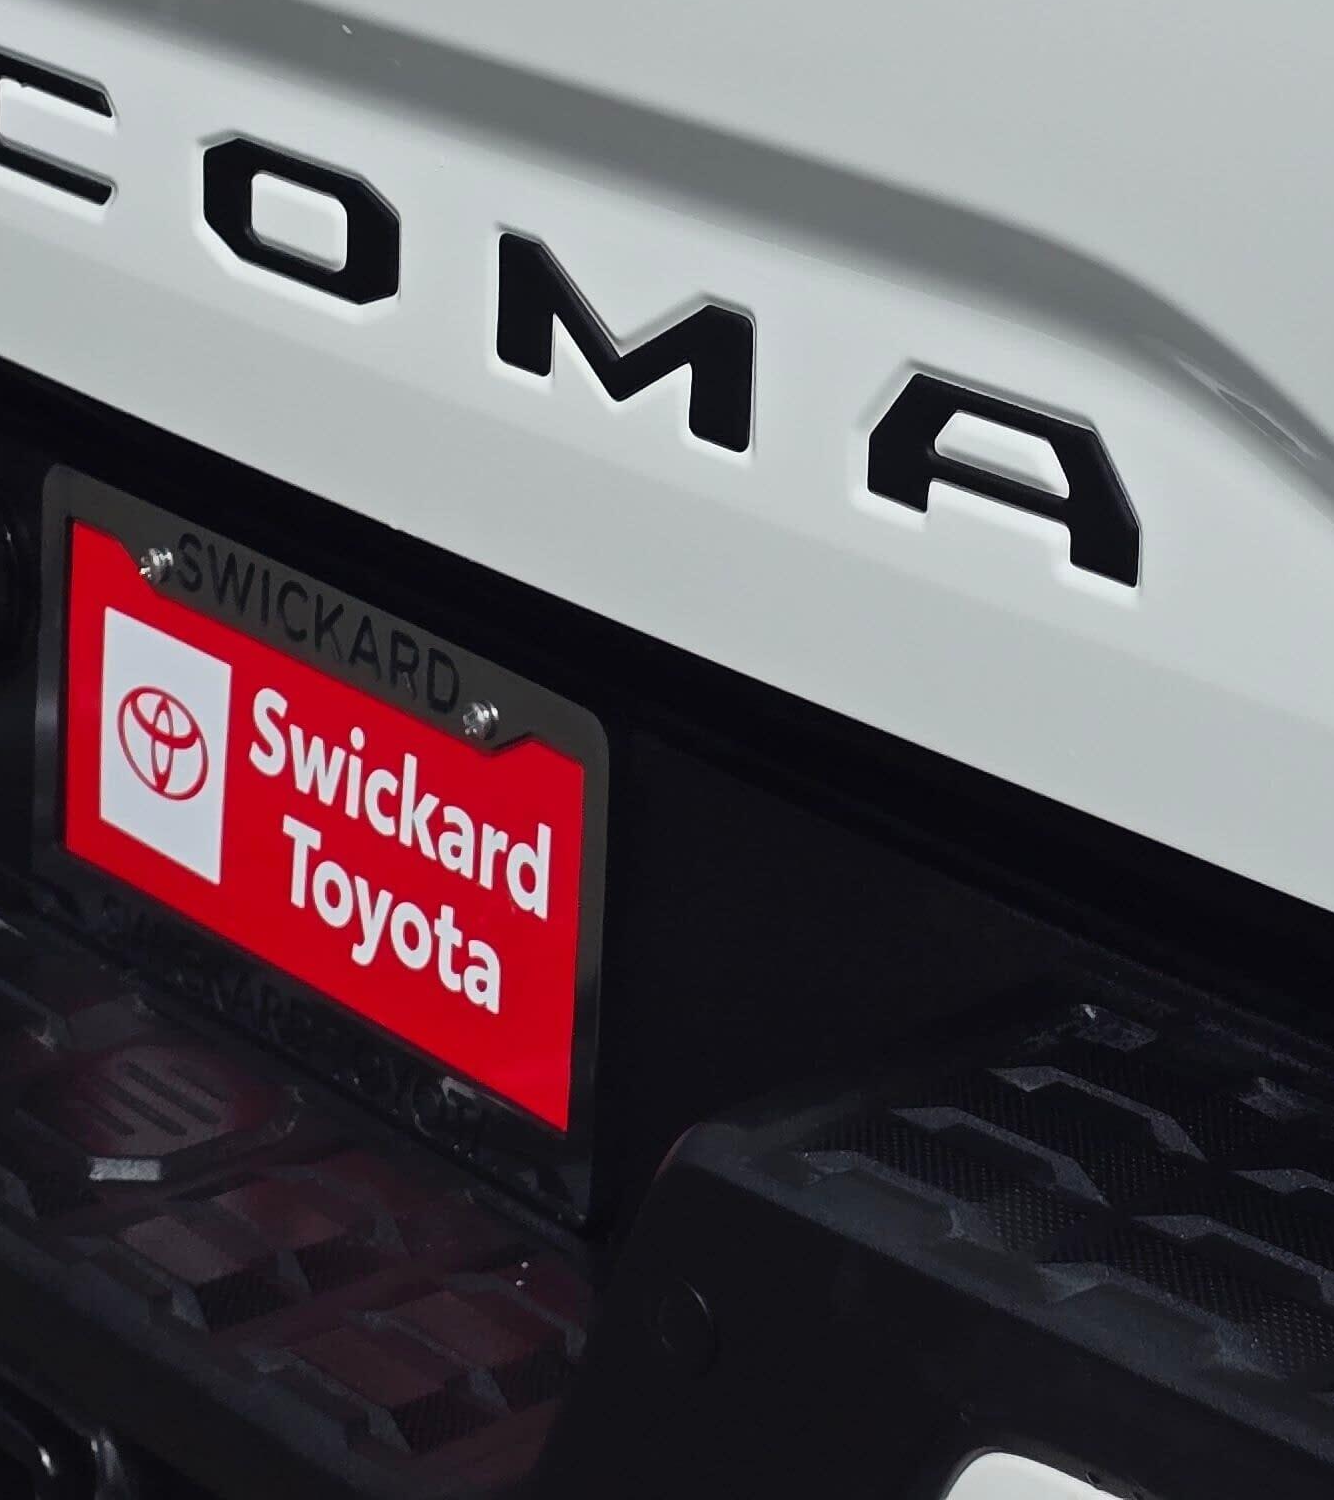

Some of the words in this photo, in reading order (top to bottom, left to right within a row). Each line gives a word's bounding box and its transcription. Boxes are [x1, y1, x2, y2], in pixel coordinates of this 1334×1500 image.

[175, 532, 462, 715] SWICKARD
[248, 686, 552, 921] Swickard
[281, 814, 501, 1015] Toyota
